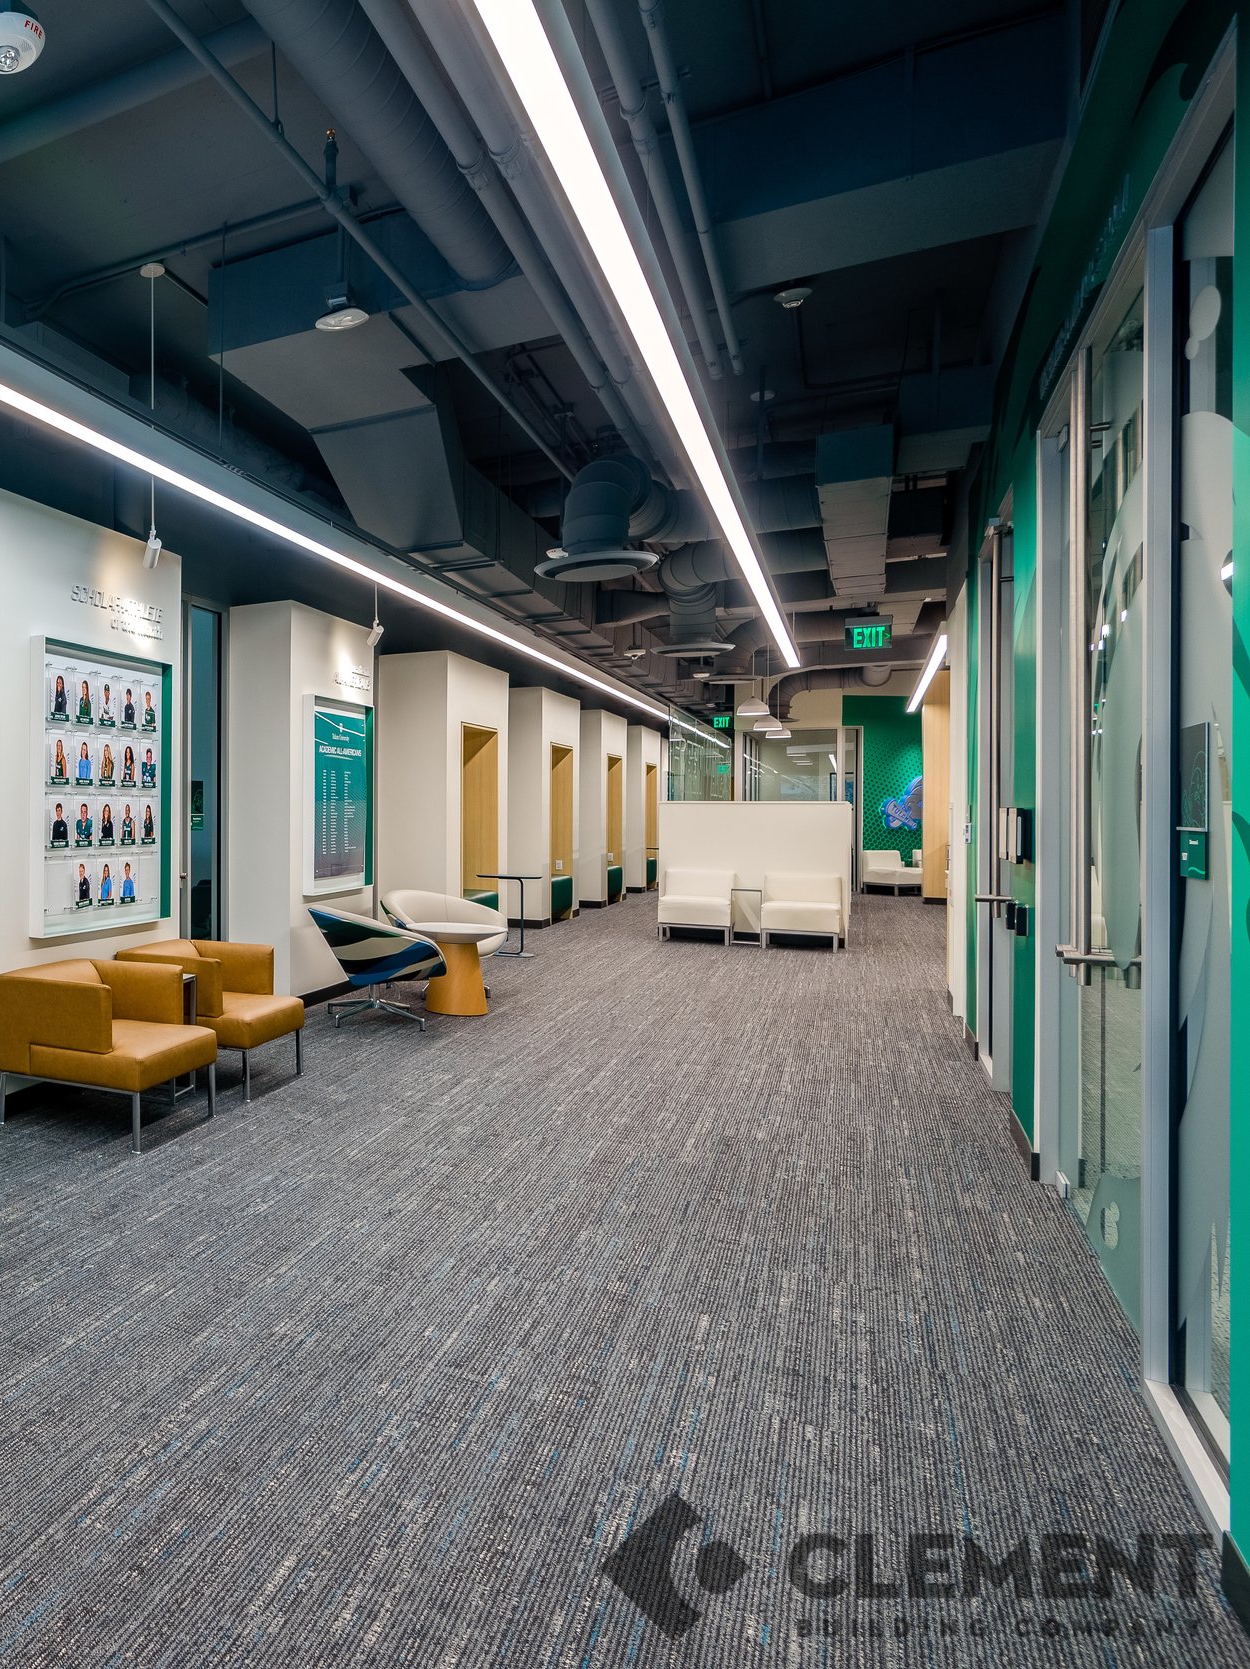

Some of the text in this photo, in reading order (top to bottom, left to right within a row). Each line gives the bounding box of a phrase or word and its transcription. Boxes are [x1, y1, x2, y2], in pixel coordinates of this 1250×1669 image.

[24, 19, 43, 39] FIRE
[853, 626, 886, 648] EXIT
[713, 716, 730, 728] EXIT
[319, 745, 337, 754] ACADEMIC
